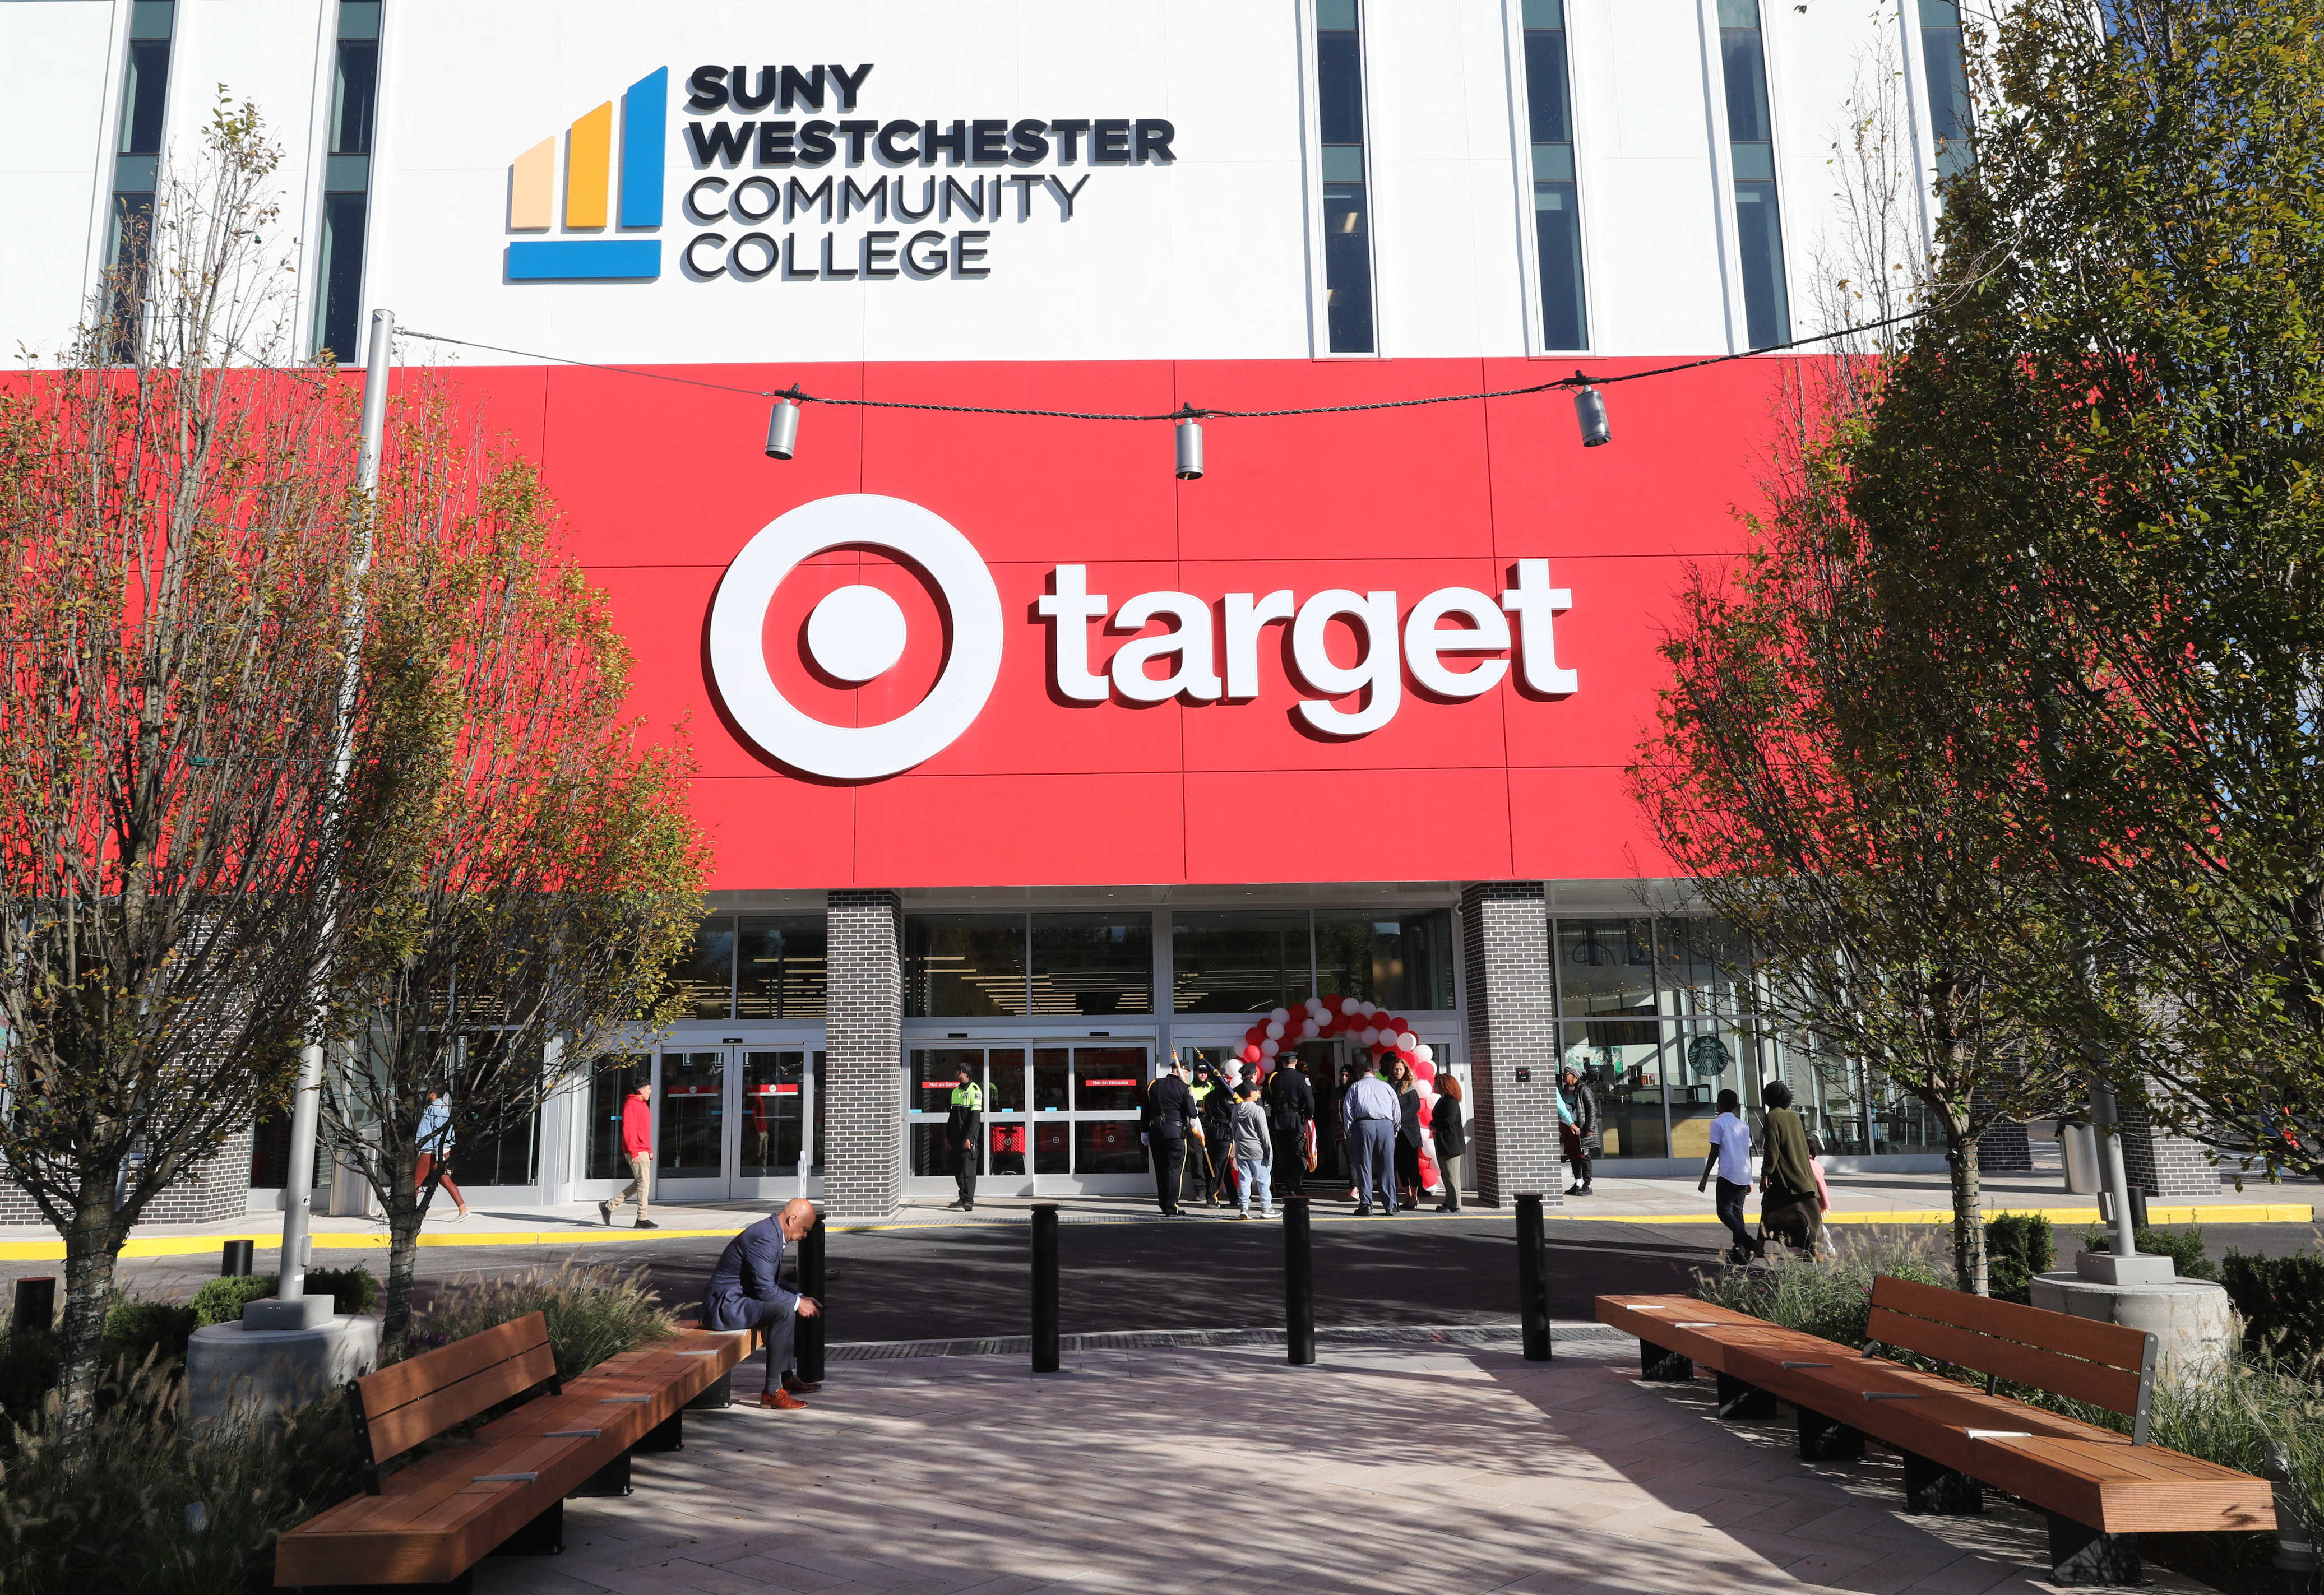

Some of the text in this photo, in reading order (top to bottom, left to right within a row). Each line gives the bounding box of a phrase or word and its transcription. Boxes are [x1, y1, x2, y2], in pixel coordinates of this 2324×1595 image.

[689, 63, 874, 111] SUNY
[688, 119, 1176, 165] WESTCHESTER
[688, 174, 1091, 221] COMMUNITY
[687, 230, 991, 278] COLLEGE
[1039, 558, 1578, 735] target
